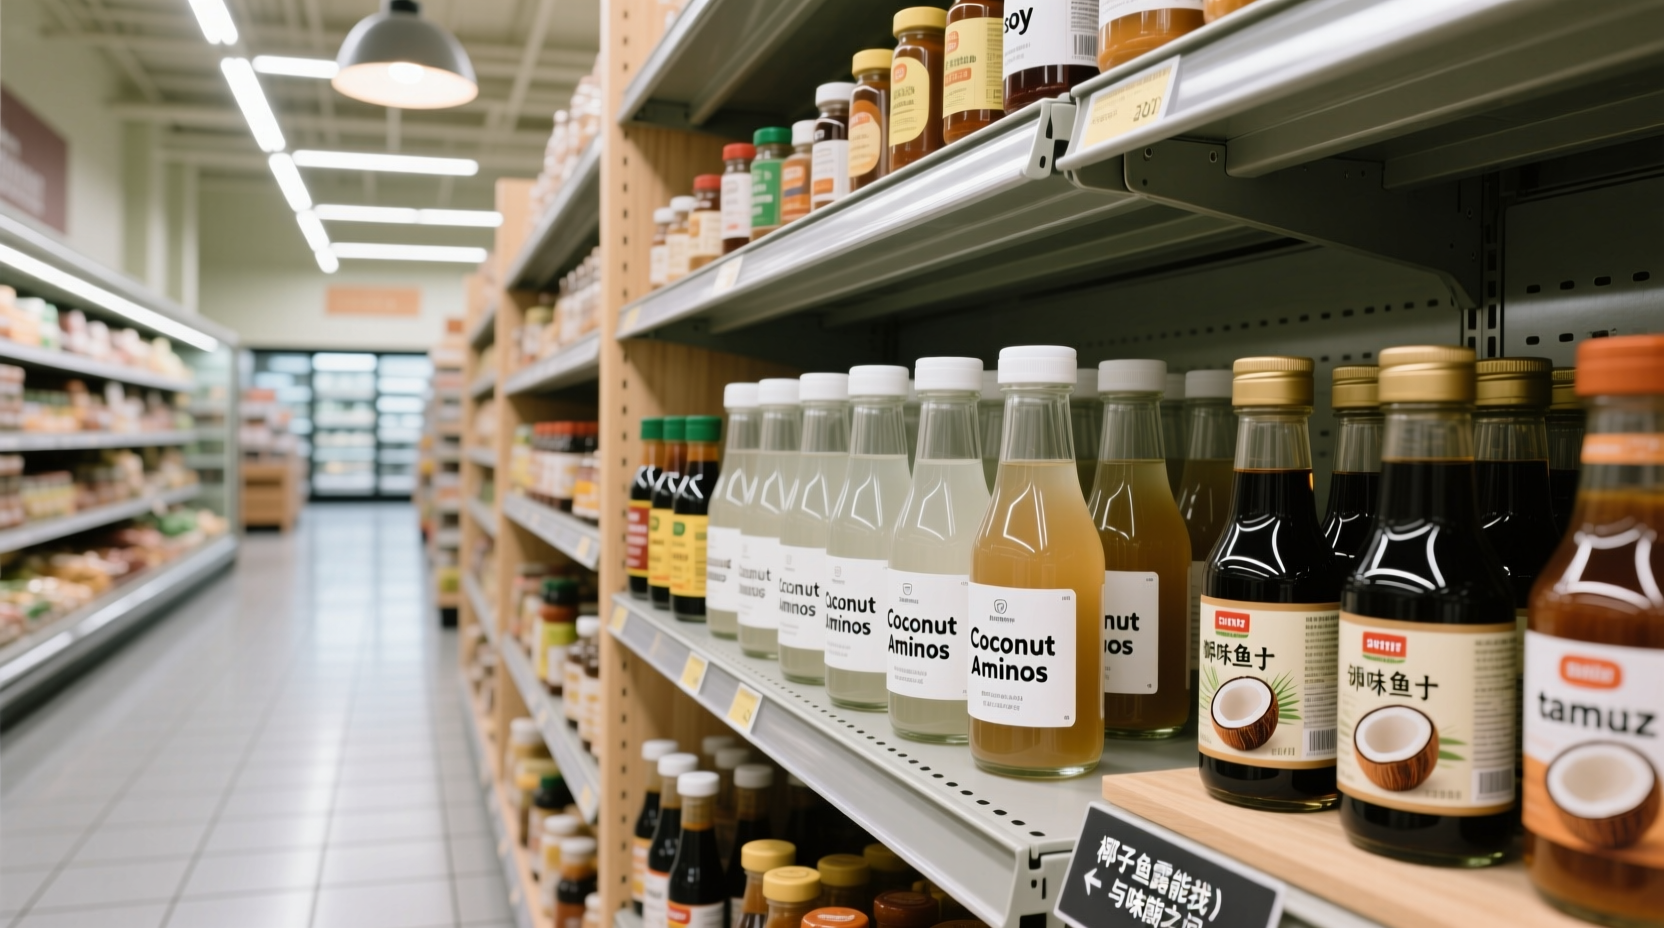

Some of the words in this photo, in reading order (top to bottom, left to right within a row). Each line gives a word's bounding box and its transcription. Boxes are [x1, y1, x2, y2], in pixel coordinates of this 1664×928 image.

[1004, 7, 1033, 36] soy
[887, 608, 958, 636] Coconut
[888, 633, 950, 660] Aminos
[970, 626, 1056, 657] Coconut
[971, 655, 1048, 683] Aminos
[1538, 691, 1656, 739] tamuz
